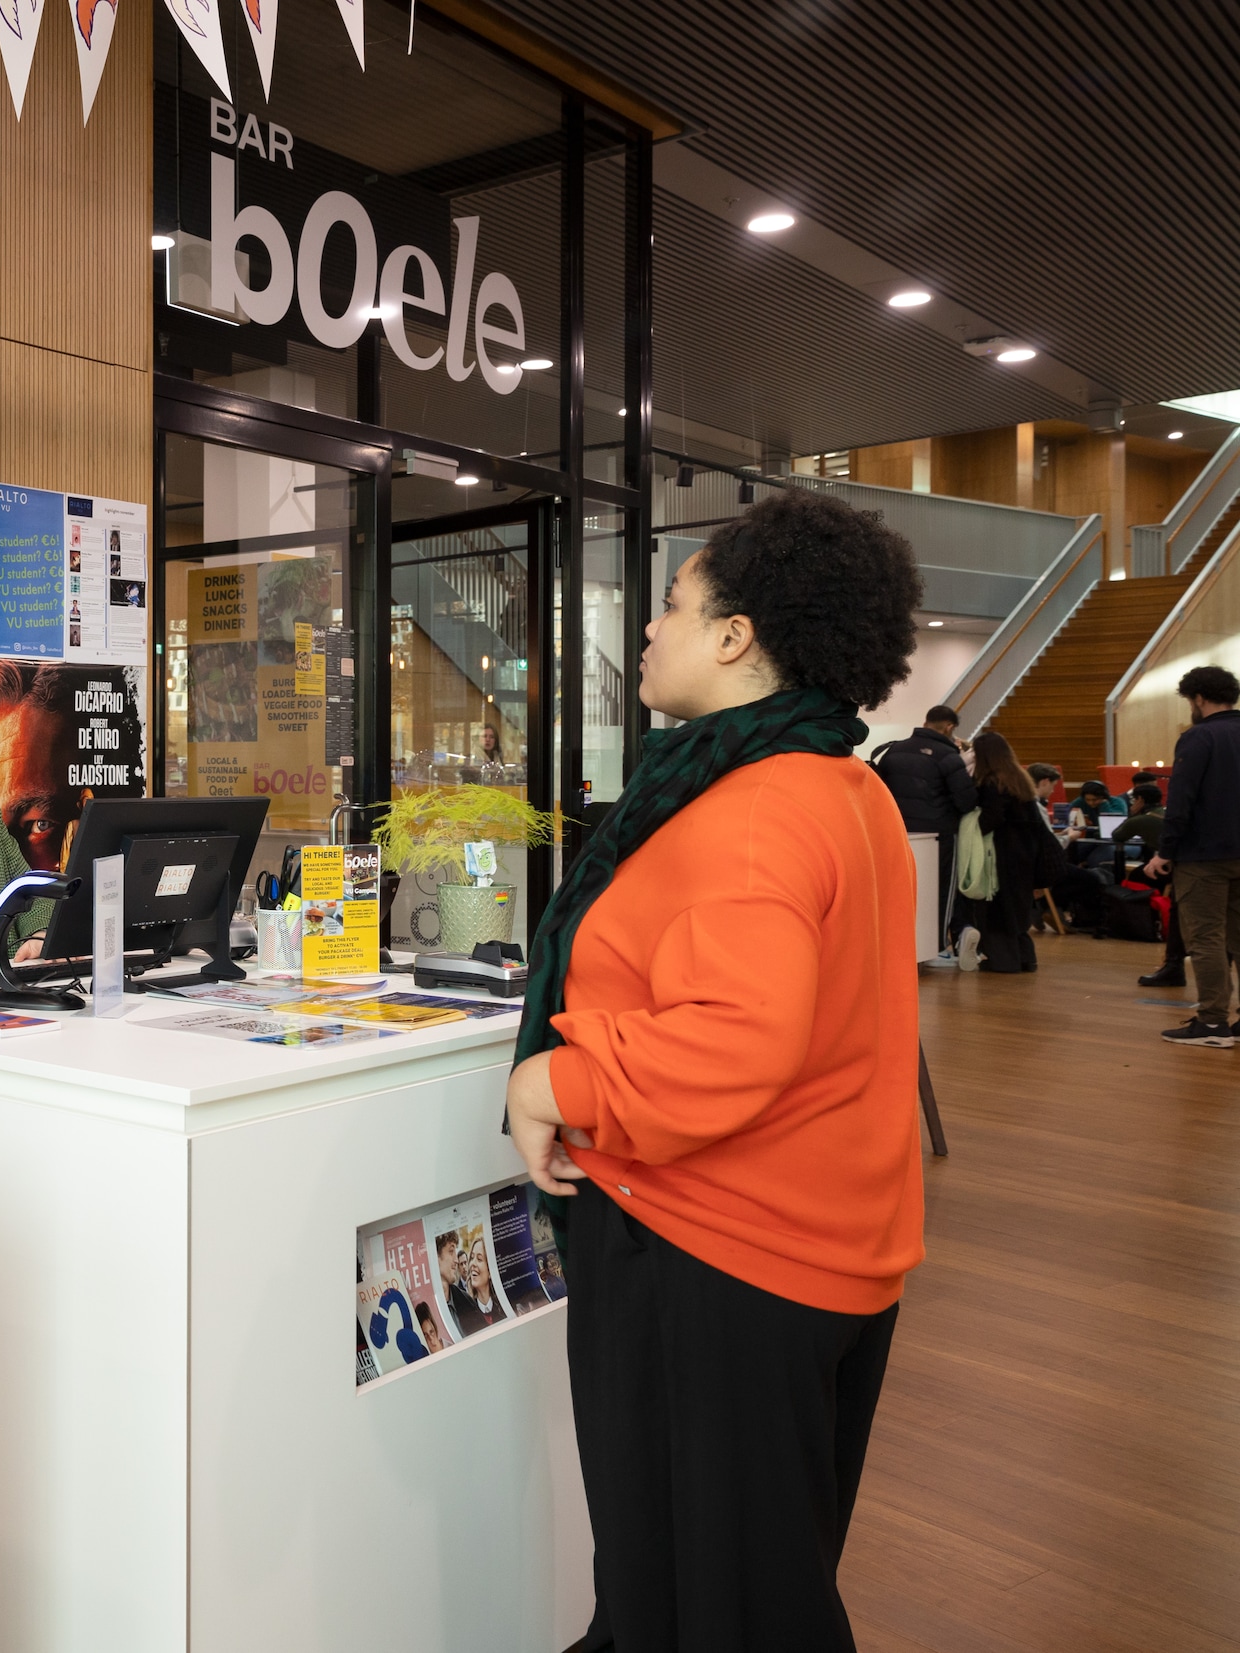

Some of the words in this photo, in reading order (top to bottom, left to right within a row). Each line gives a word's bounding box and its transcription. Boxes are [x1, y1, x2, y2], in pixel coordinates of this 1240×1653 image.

[211, 97, 294, 170] BAR
[1, 504, 10, 512] VU
[0, 535, 39, 547] student?
[41, 535, 60, 546] €6!
[2, 551, 41, 563] student?
[7, 567, 46, 579] student?
[204, 574, 245, 587] DRINKS
[12, 583, 51, 595] student?
[206, 589, 244, 601] LUNCH
[0, 601, 16, 612] VU
[19, 601, 58, 612] student?
[203, 603, 247, 616] SNACKS
[7, 617, 22, 628] VU
[25, 616, 64, 628] student?
[204, 618, 245, 631] DINNER
[88, 681, 112, 691] LEONARDO
[273, 679, 295, 687] BURG
[262, 690, 296, 698] LOADED
[264, 701, 295, 709] VEGGIE
[298, 700, 322, 708] FOOD
[268, 712, 319, 720] SMOOTHIES
[90, 718, 108, 728] ROBERT
[278, 723, 308, 731] SWEET
[78, 728, 92, 749] DE
[94, 729, 119, 749] NIRO
[94, 755, 104, 764] LILY
[68, 764, 129, 786] GLADSTONE
[209, 785, 233, 796] Qeet
[163, 869, 193, 877] RIALTO
[158, 883, 188, 893] RIALTO
[388, 1243, 414, 1271] HET
[360, 1278, 399, 1305] RIALTO
